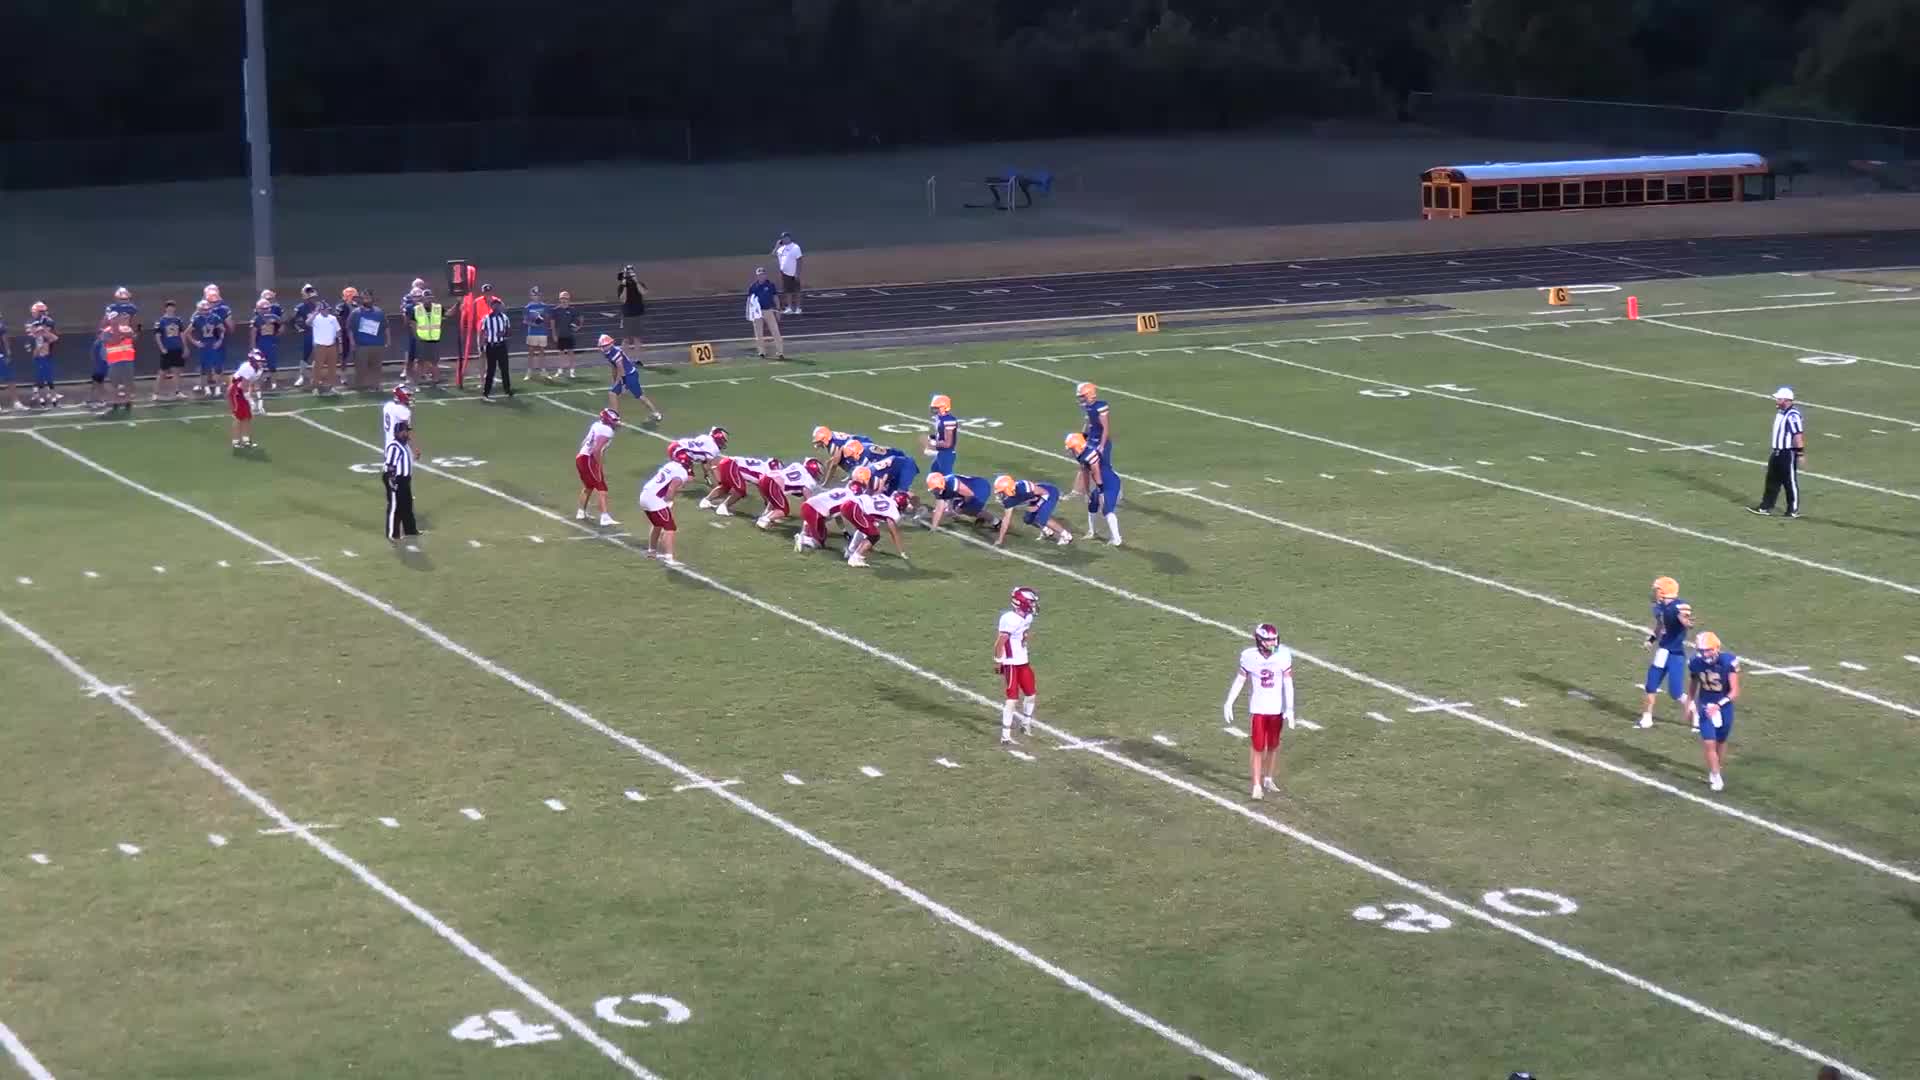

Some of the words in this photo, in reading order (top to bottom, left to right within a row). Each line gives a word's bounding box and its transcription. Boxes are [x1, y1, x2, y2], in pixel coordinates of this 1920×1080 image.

[1557, 288, 1566, 302] G
[1142, 315, 1156, 329] 10
[697, 346, 711, 361] 20
[1261, 669, 1274, 688] 2
[1700, 669, 1723, 692] 15
